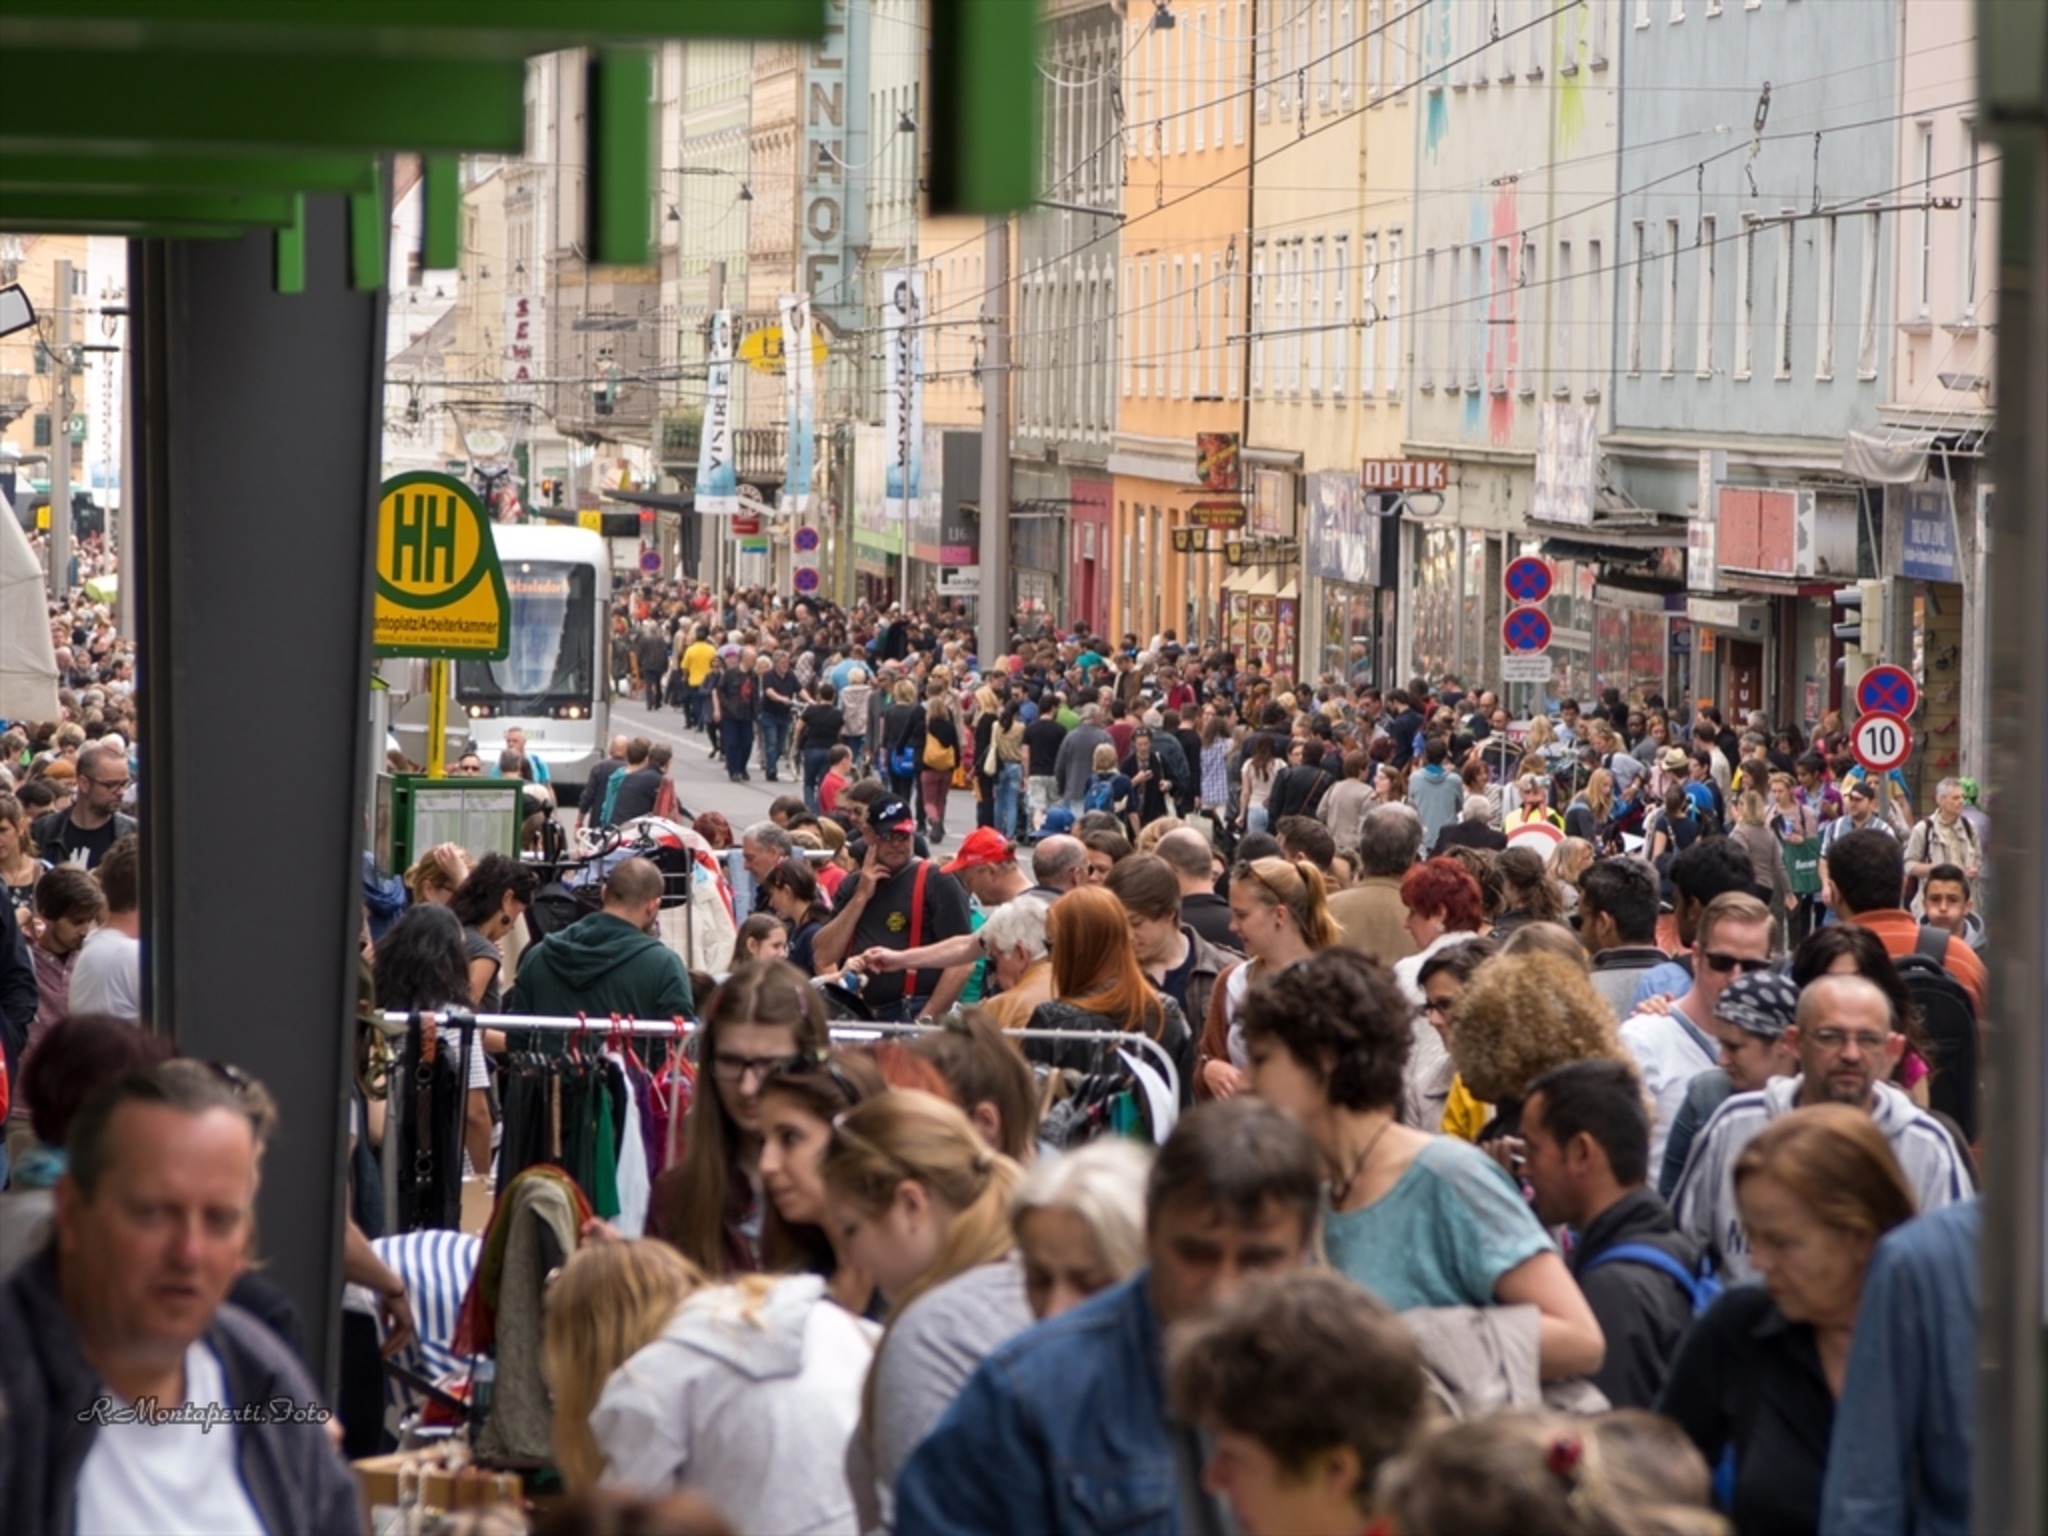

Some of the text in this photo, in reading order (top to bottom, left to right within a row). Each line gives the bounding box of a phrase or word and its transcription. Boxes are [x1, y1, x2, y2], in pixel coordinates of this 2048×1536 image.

[1365, 462, 1443, 487] OPTIK
[392, 494, 457, 583] HH
[1866, 725, 1895, 756] 10
